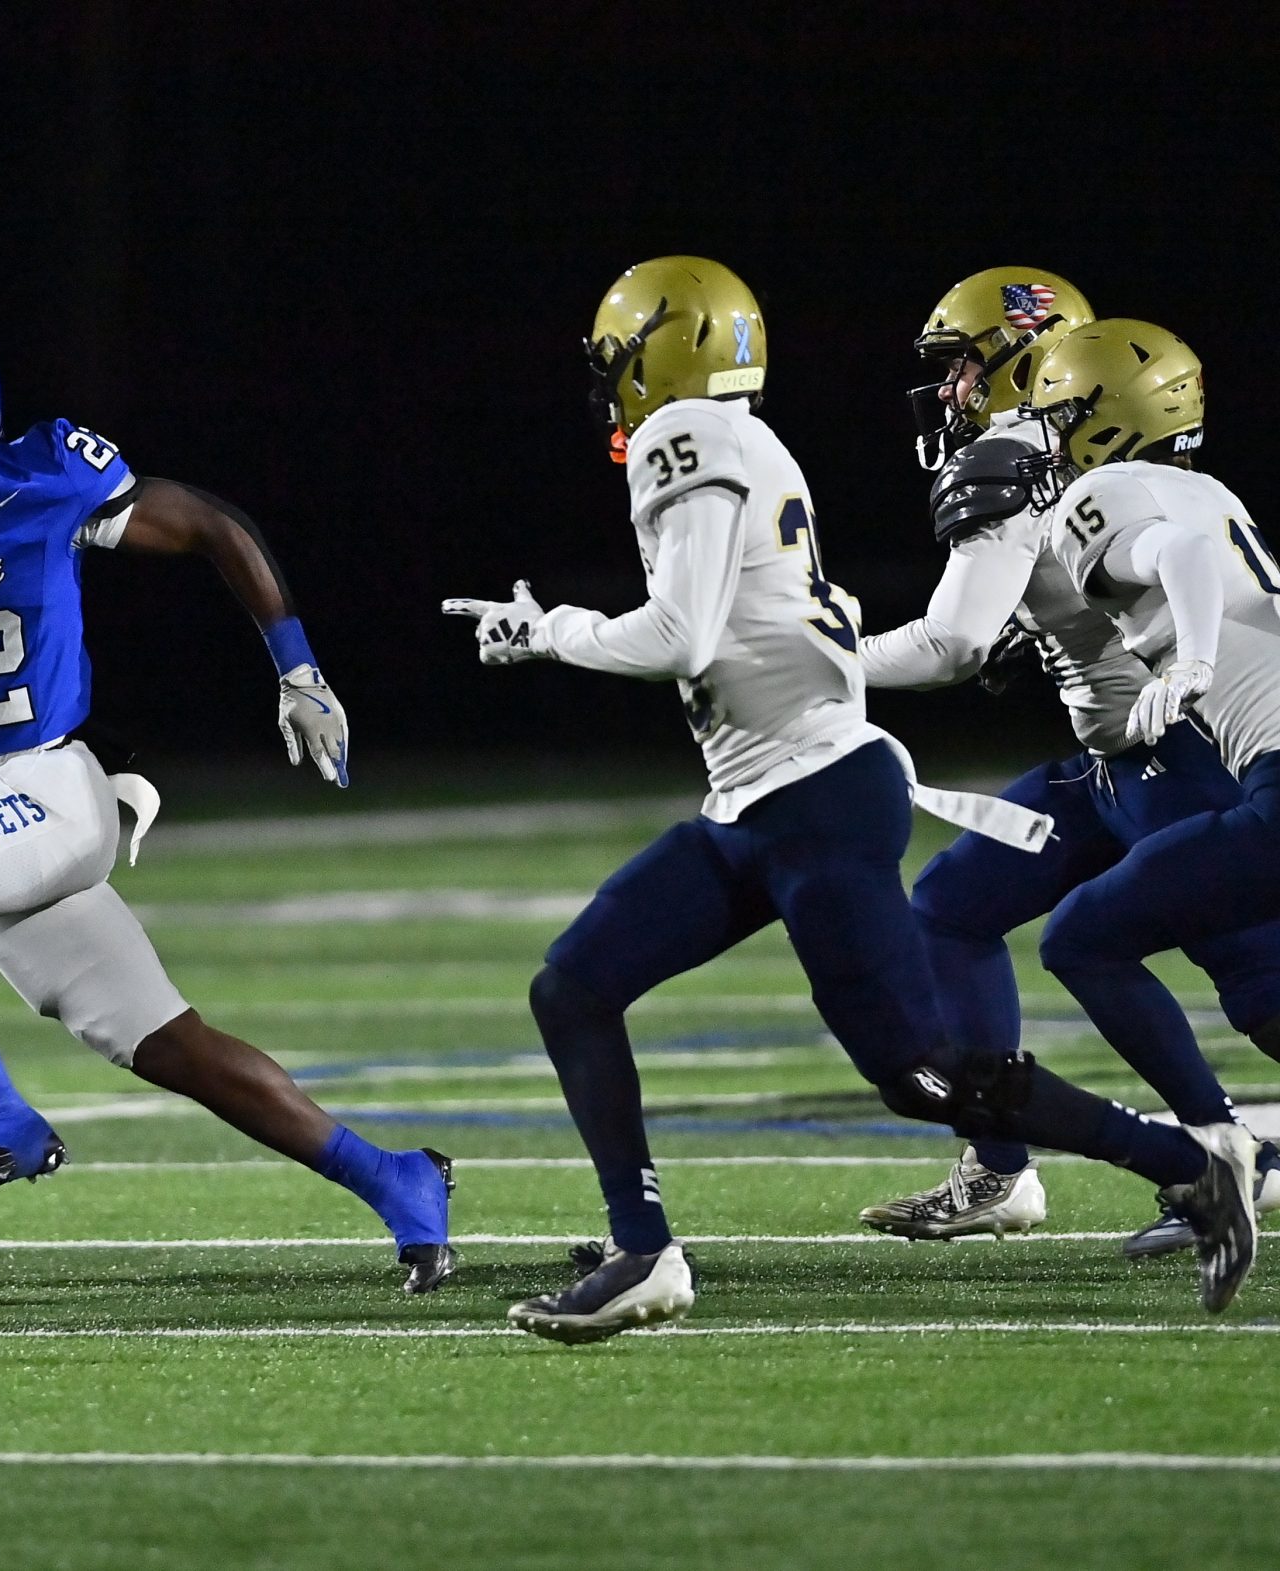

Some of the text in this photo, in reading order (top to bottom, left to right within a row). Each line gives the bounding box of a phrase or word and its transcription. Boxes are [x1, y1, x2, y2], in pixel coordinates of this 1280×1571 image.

[721, 373, 760, 389] VICIS
[66, 426, 120, 471] 2
[646, 432, 699, 489] 35
[1065, 494, 1105, 551] 15
[773, 493, 862, 661] 3
